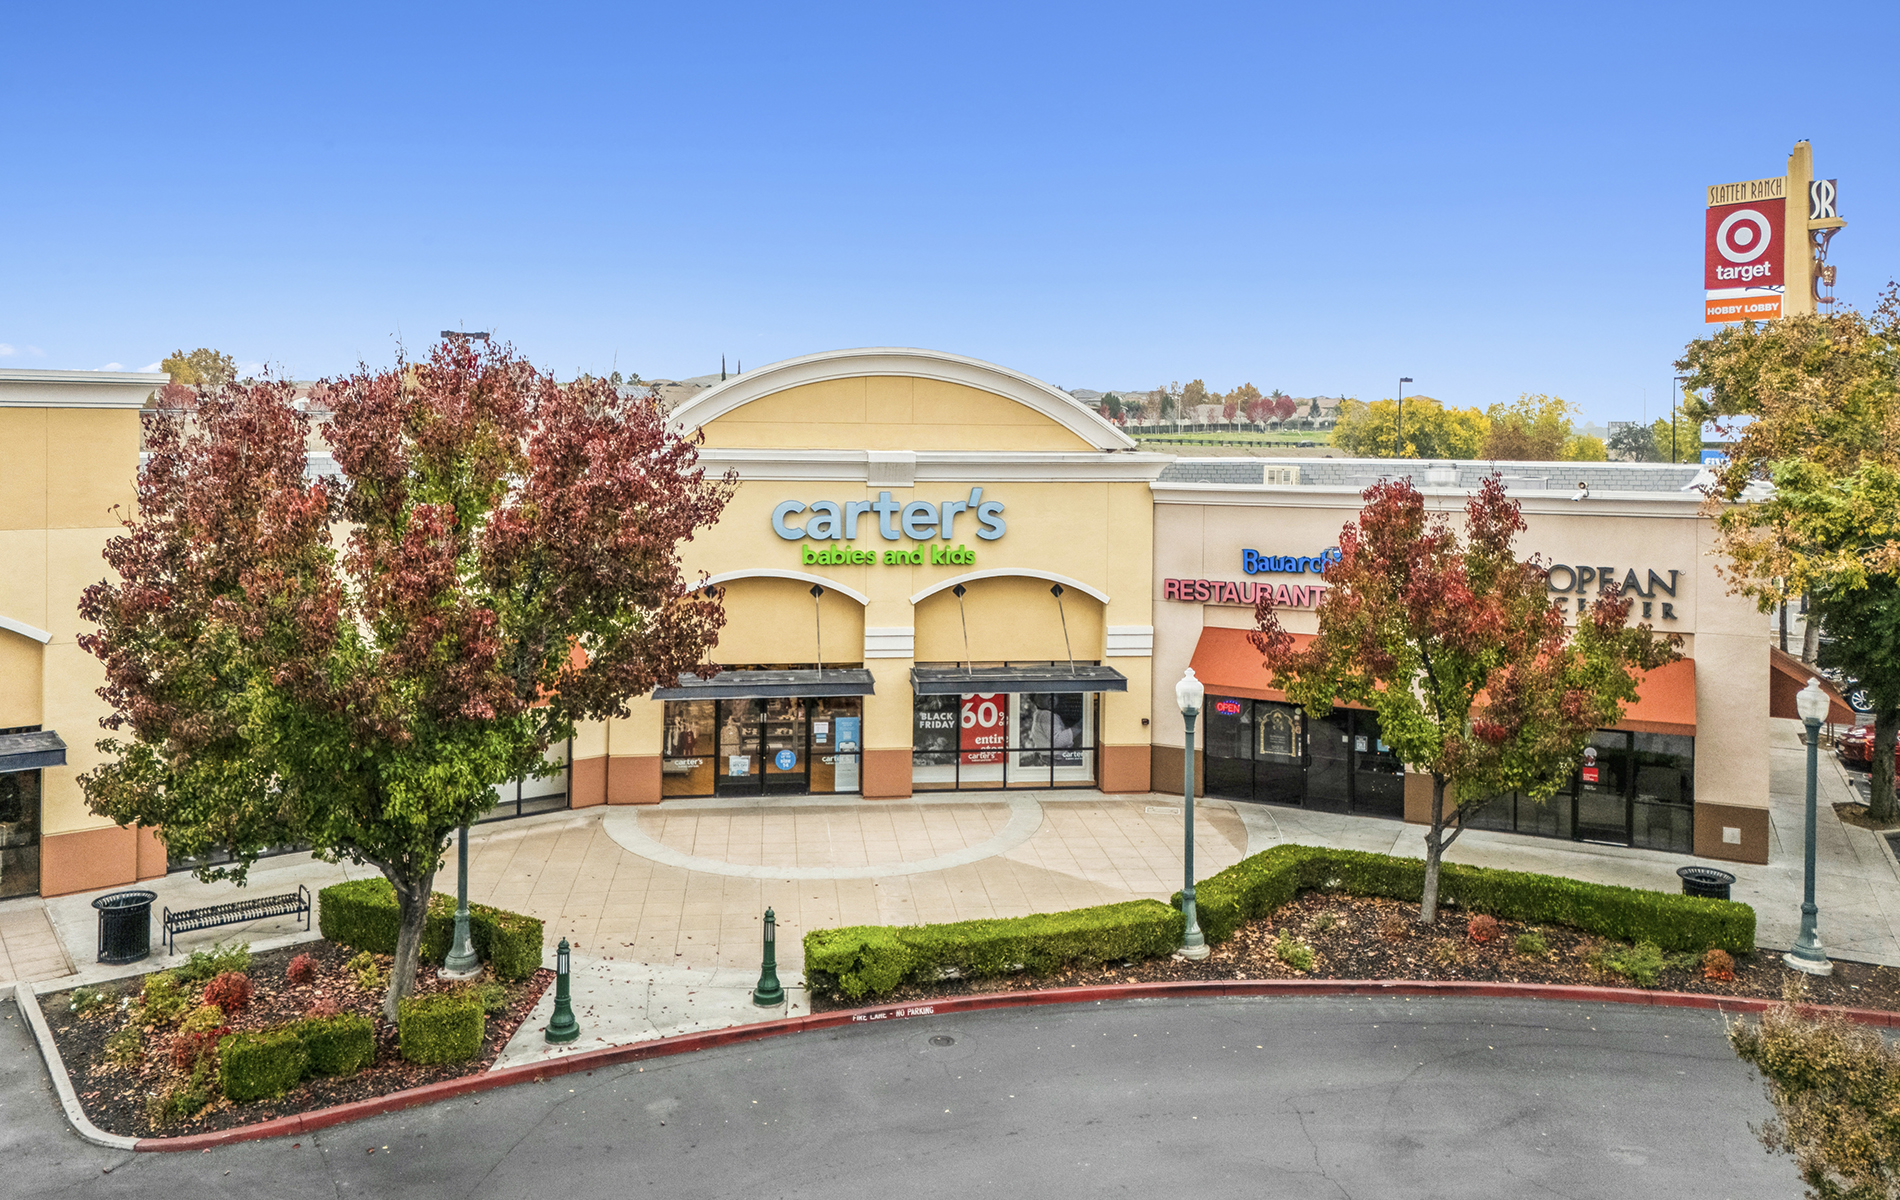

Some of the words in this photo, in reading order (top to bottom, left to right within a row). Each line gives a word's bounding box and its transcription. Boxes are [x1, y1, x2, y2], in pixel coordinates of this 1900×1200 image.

[1710, 183, 1746, 204] SLATTEN
[1751, 178, 1782, 199] RANCH
[1809, 180, 1836, 220] SR
[1716, 261, 1771, 281] target
[1707, 306, 1742, 316] HOBBY
[1745, 303, 1779, 313] LOBBY
[771, 487, 1006, 541] carter's
[802, 544, 876, 566] babies
[883, 544, 924, 566] and
[931, 544, 976, 566] kids
[1531, 564, 1679, 598] OPEAN
[1163, 578, 1327, 608] RESTAURANT
[921, 712, 953, 721] BLACK
[1216, 702, 1240, 713] OPEN
[919, 720, 955, 729] FRIDAY
[674, 758, 703, 766] carter's
[895, 1008, 905, 1018] NO
[907, 1005, 934, 1016] PARKING
